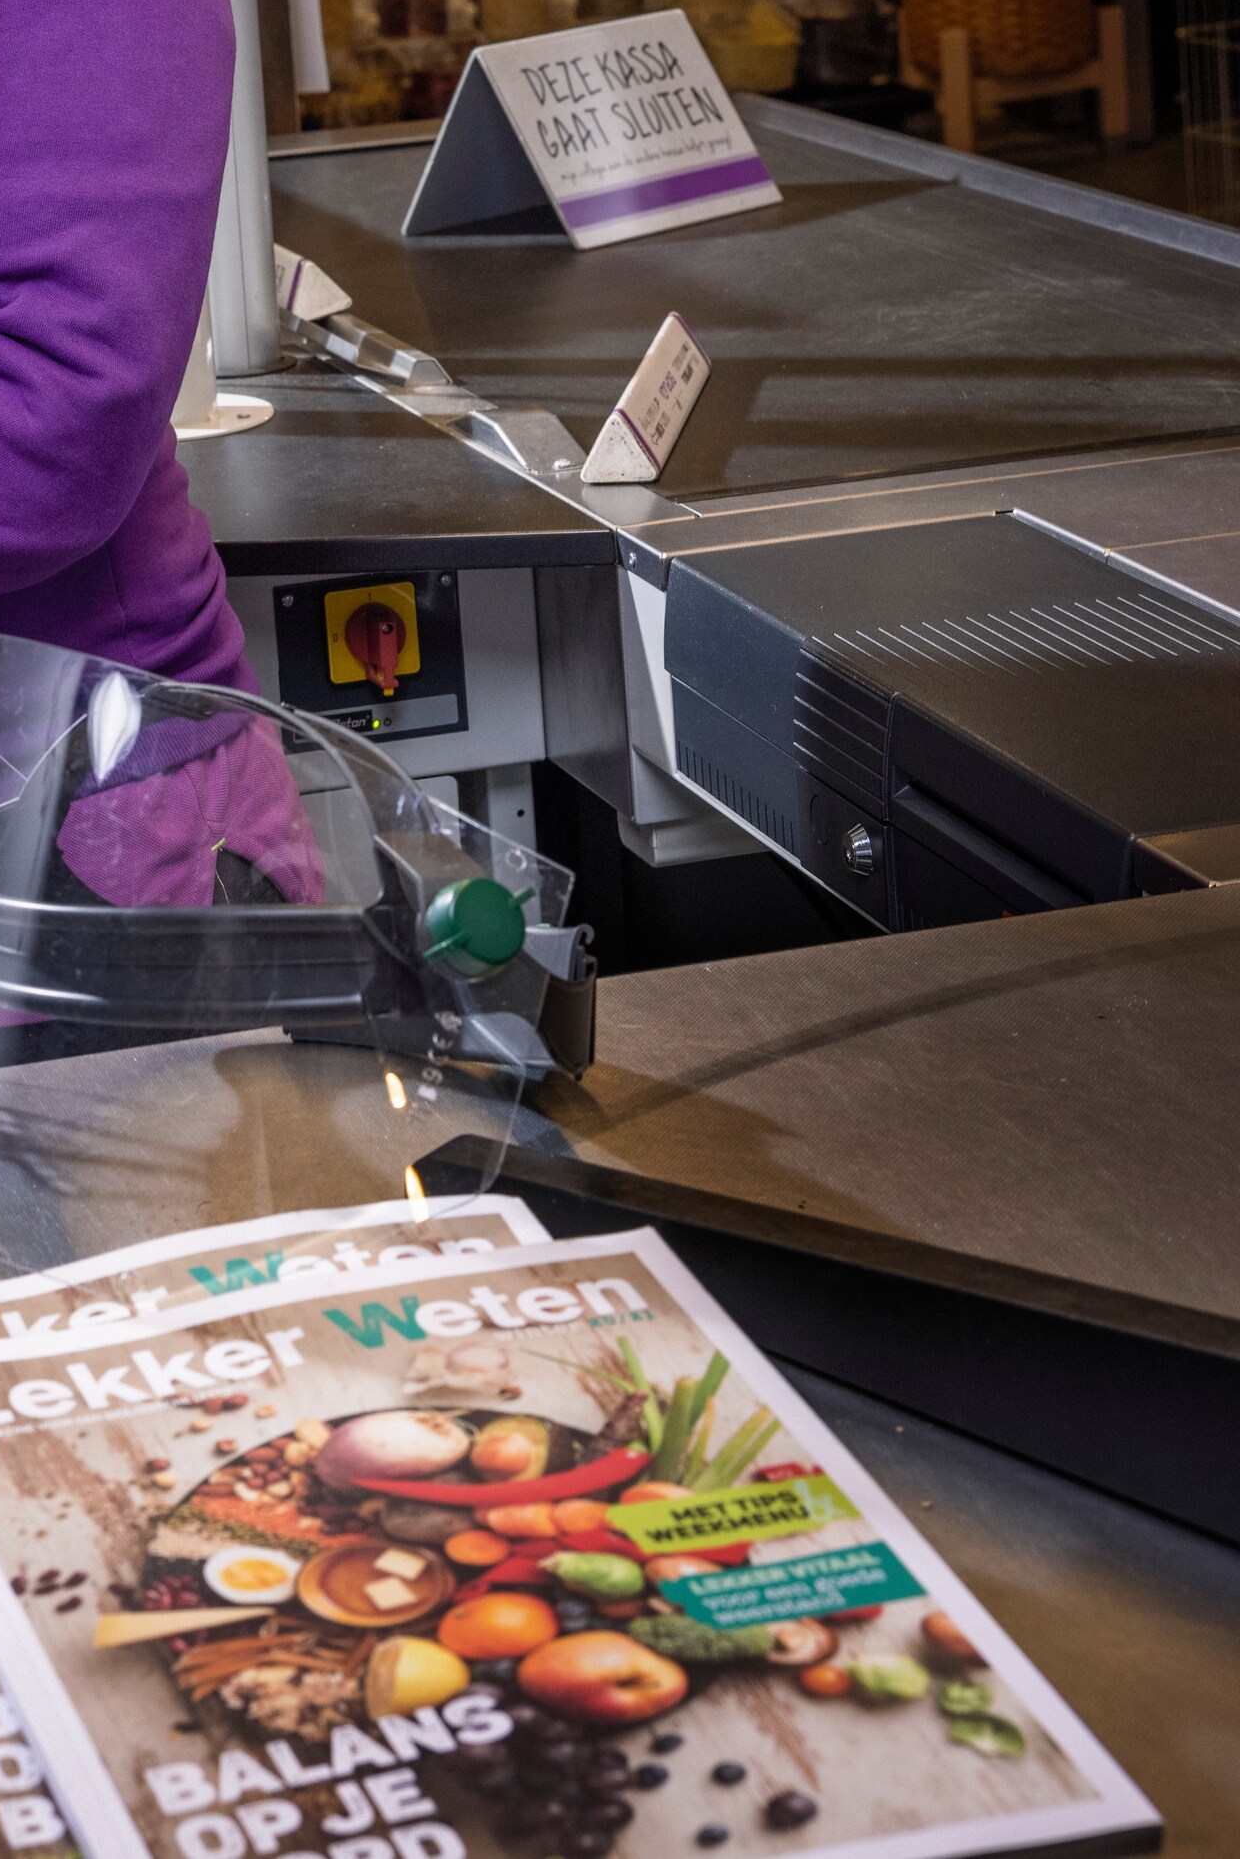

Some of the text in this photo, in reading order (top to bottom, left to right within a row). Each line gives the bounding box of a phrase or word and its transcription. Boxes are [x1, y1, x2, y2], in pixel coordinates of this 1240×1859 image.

[520, 40, 686, 106] DEZE KASSA
[536, 85, 724, 160] GAAT SLUITEN
[322, 1276, 651, 1349] Weten
[644, 1504, 811, 1542] WEEKMENU
[671, 1489, 800, 1522] MET TIPS
[144, 1693, 515, 1816] BALANS
[174, 1798, 303, 1859] OP
[320, 1767, 438, 1837] JE
